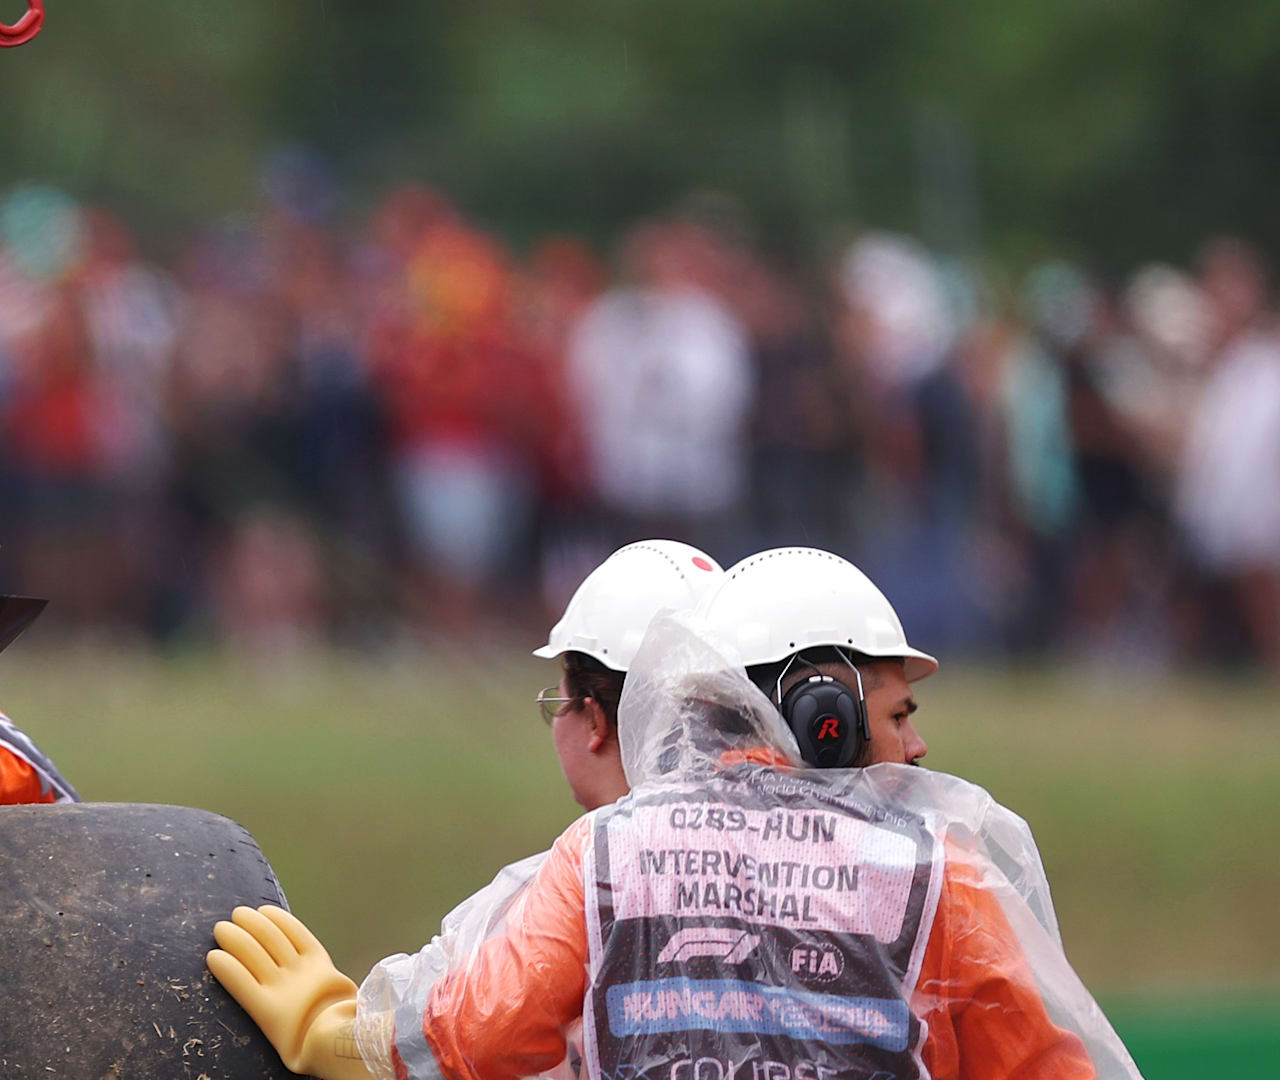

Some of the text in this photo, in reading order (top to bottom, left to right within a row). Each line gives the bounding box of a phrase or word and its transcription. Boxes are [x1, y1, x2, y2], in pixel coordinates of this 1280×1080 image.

[817, 718, 840, 740] R
[670, 806, 837, 843] 0289-HUN
[640, 849, 859, 892] INTERVENTION
[676, 881, 819, 923] MARSHAL
[623, 989, 781, 1024] HUNGARY
